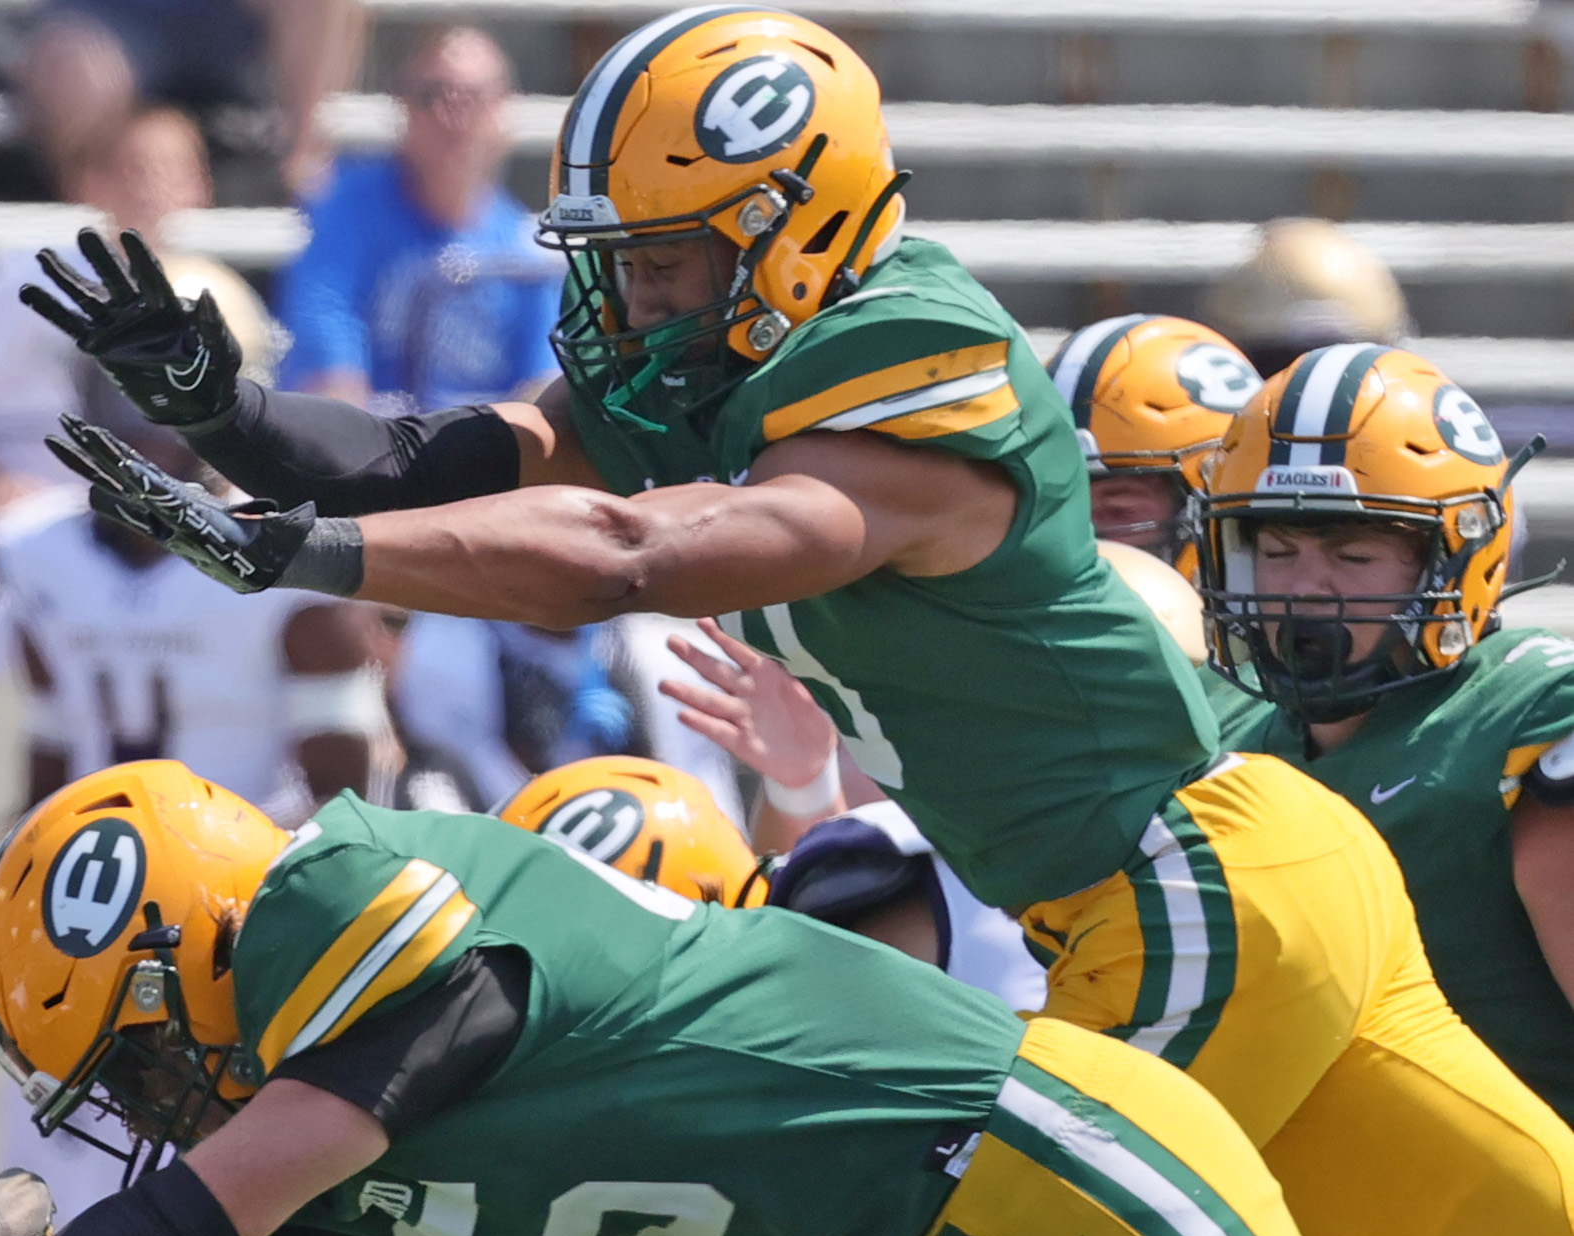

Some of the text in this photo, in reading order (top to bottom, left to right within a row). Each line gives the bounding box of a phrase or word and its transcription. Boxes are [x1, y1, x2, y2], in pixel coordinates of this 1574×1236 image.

[702, 60, 812, 157] E
[1276, 473, 1328, 486] EAGLES
[51, 830, 139, 947] E
